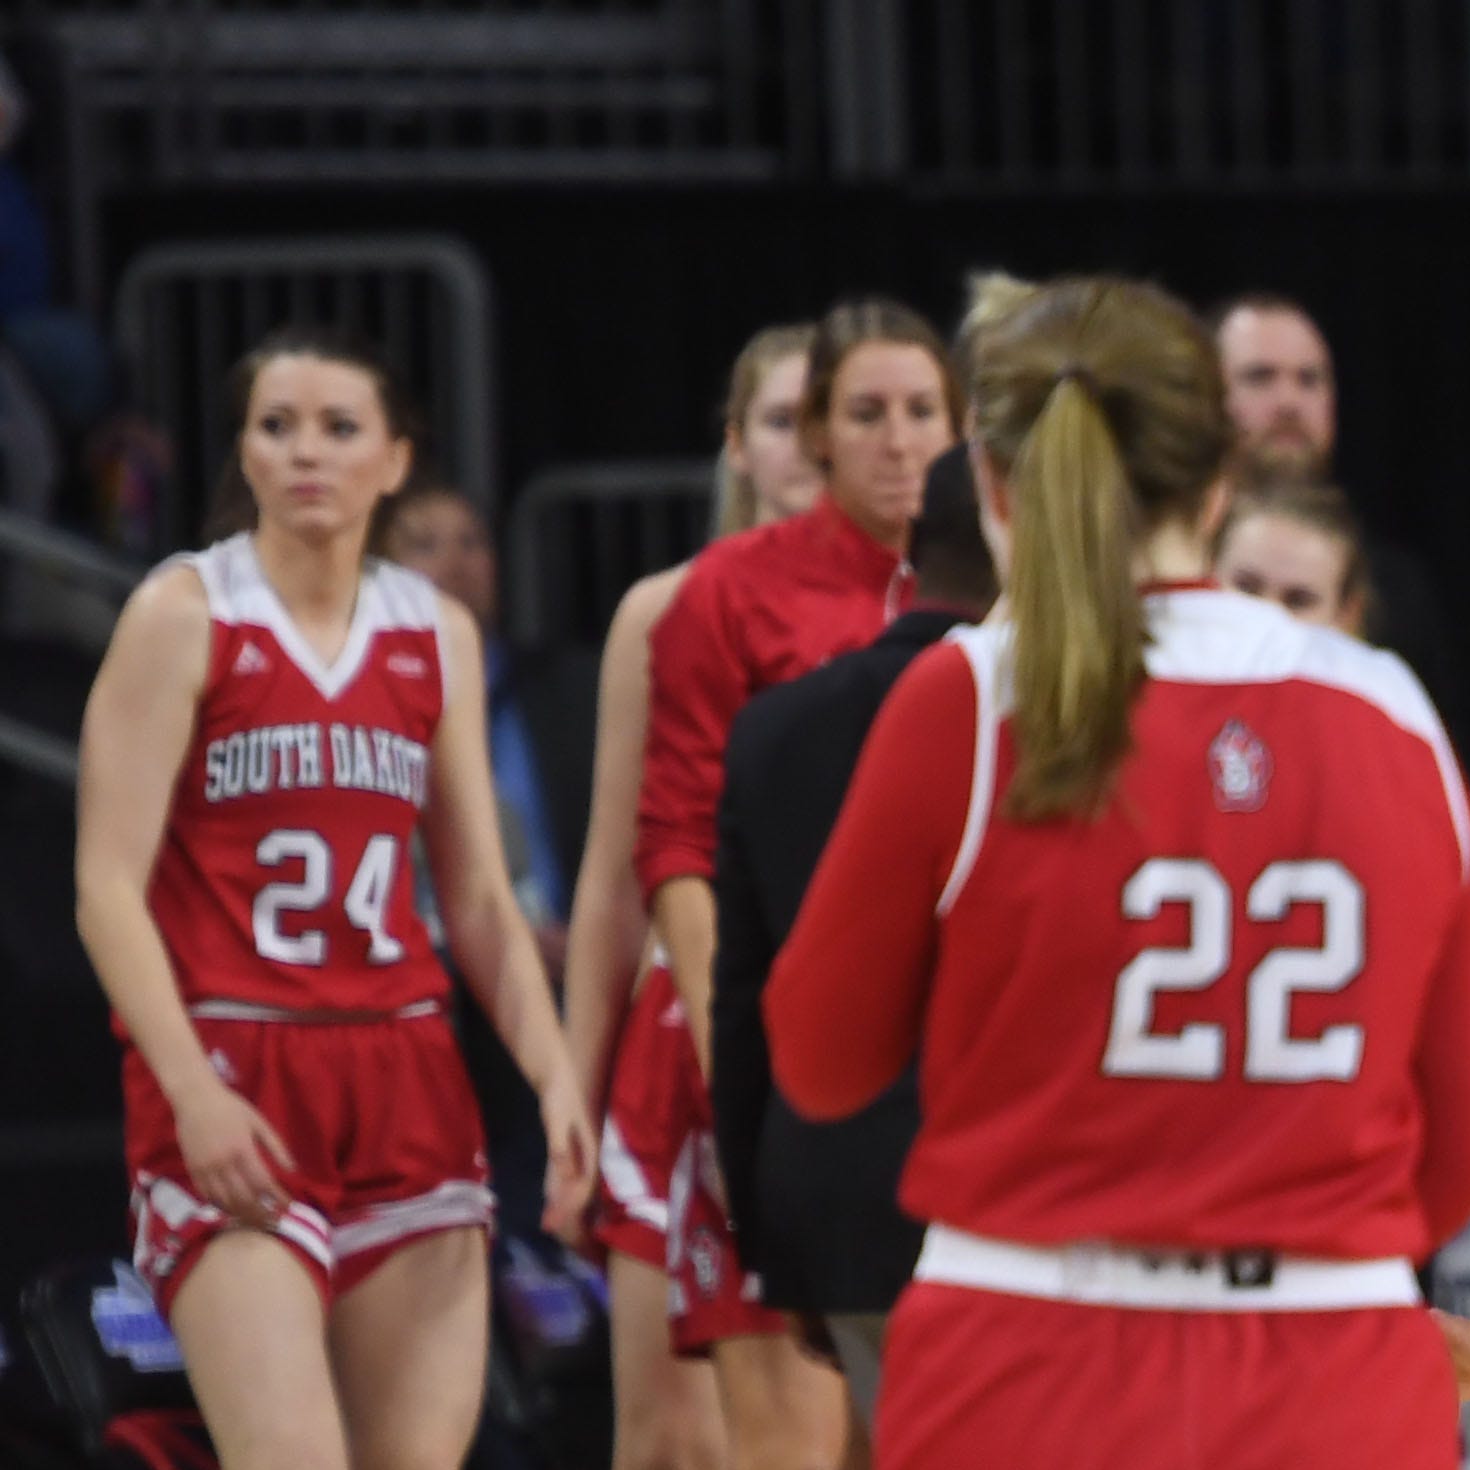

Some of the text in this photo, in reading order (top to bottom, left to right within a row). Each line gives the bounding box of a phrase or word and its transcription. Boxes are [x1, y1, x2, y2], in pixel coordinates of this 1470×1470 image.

[204, 721, 428, 809] SOUTH DAKOT
[252, 828, 405, 968] 24
[1101, 856, 1366, 1083] 22
